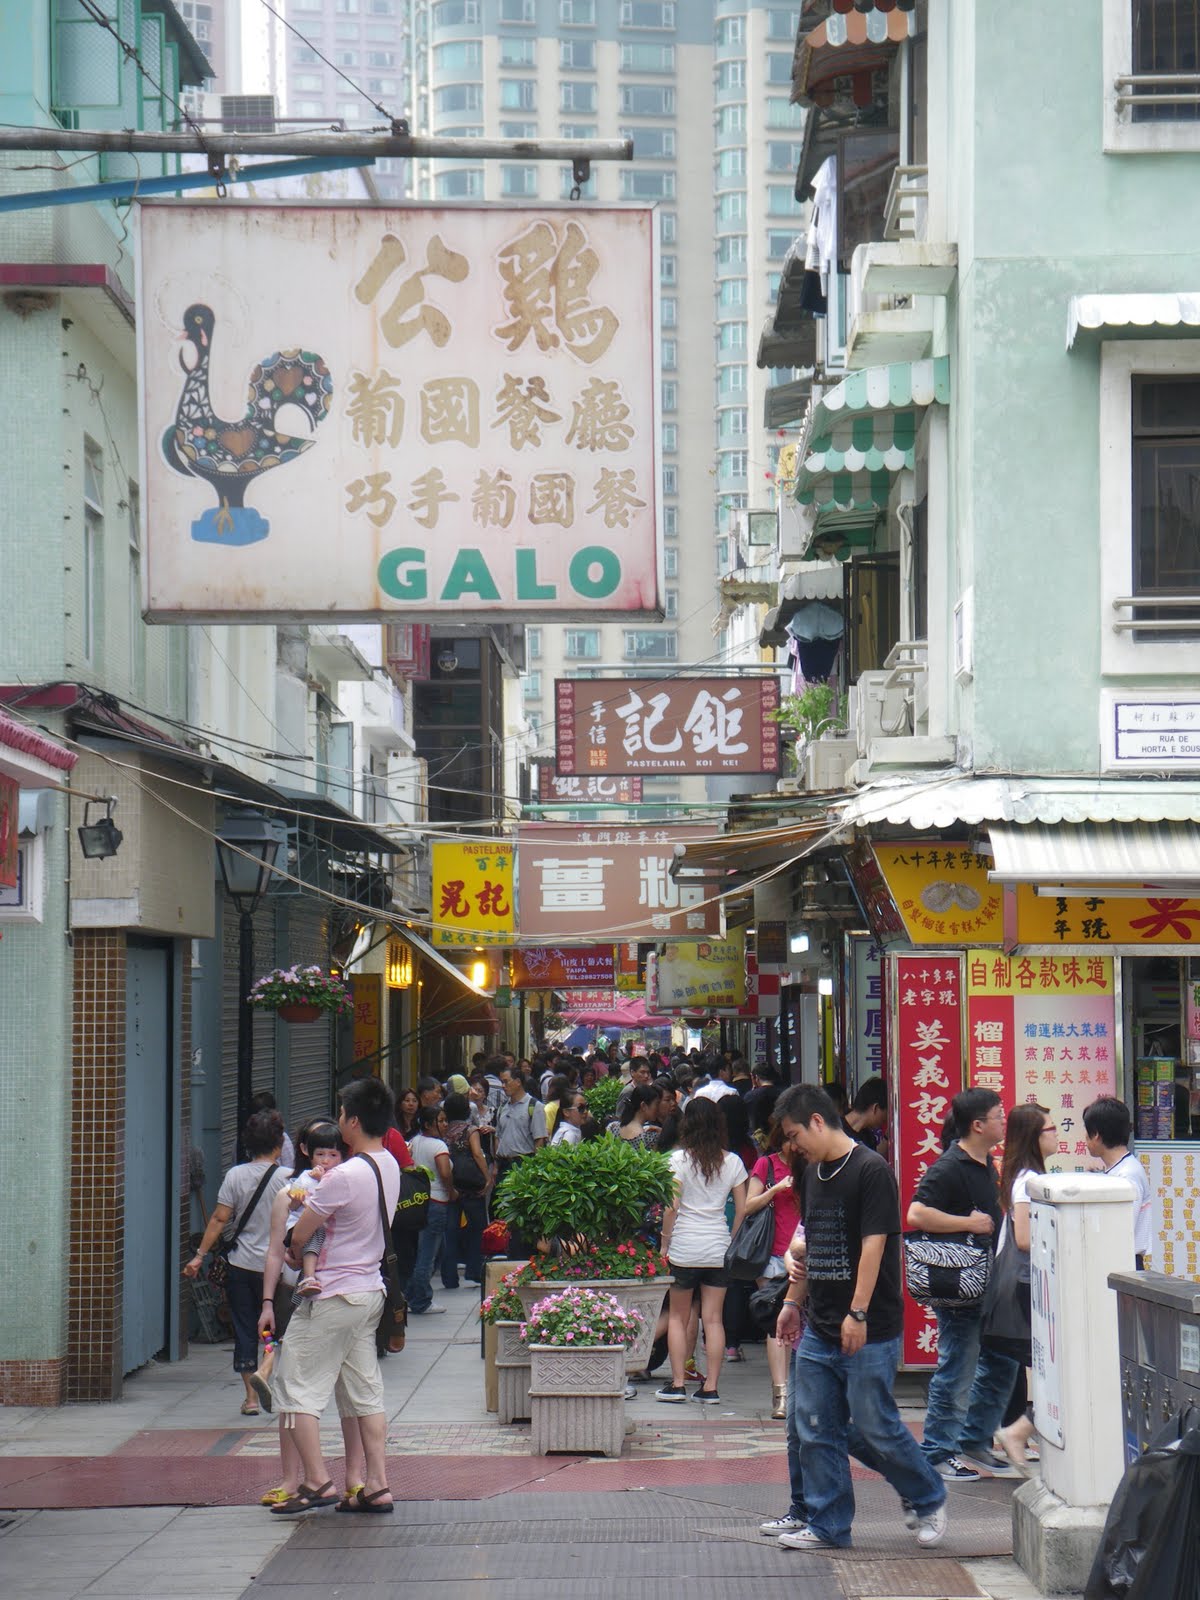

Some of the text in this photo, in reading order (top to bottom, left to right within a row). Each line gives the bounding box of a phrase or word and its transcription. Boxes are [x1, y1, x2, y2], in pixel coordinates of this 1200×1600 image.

[345, 371, 637, 453] 葡國餐廳
[345, 467, 648, 530] 巧手葡國餐
[377, 545, 622, 601] GALO
[588, 700, 608, 746] 手信
[1159, 735, 1189, 743] RUA DE
[1141, 745, 1167, 753] HORTA
[626, 759, 686, 768] PASTELARIA
[463, 846, 513, 855] PASTELARIA
[893, 850, 993, 871] 八十年老字號
[440, 880, 510, 918] 晃記
[902, 968, 957, 985] 八十多年
[971, 958, 1107, 989] 自制各款味道
[902, 988, 957, 1006] 老字號
[1024, 1023, 1108, 1038] 榴蓮糕大菜糕
[1024, 1046, 1109, 1061] 燕窩大菜糕
[1024, 1069, 1109, 1084] 芒果大菜糕
